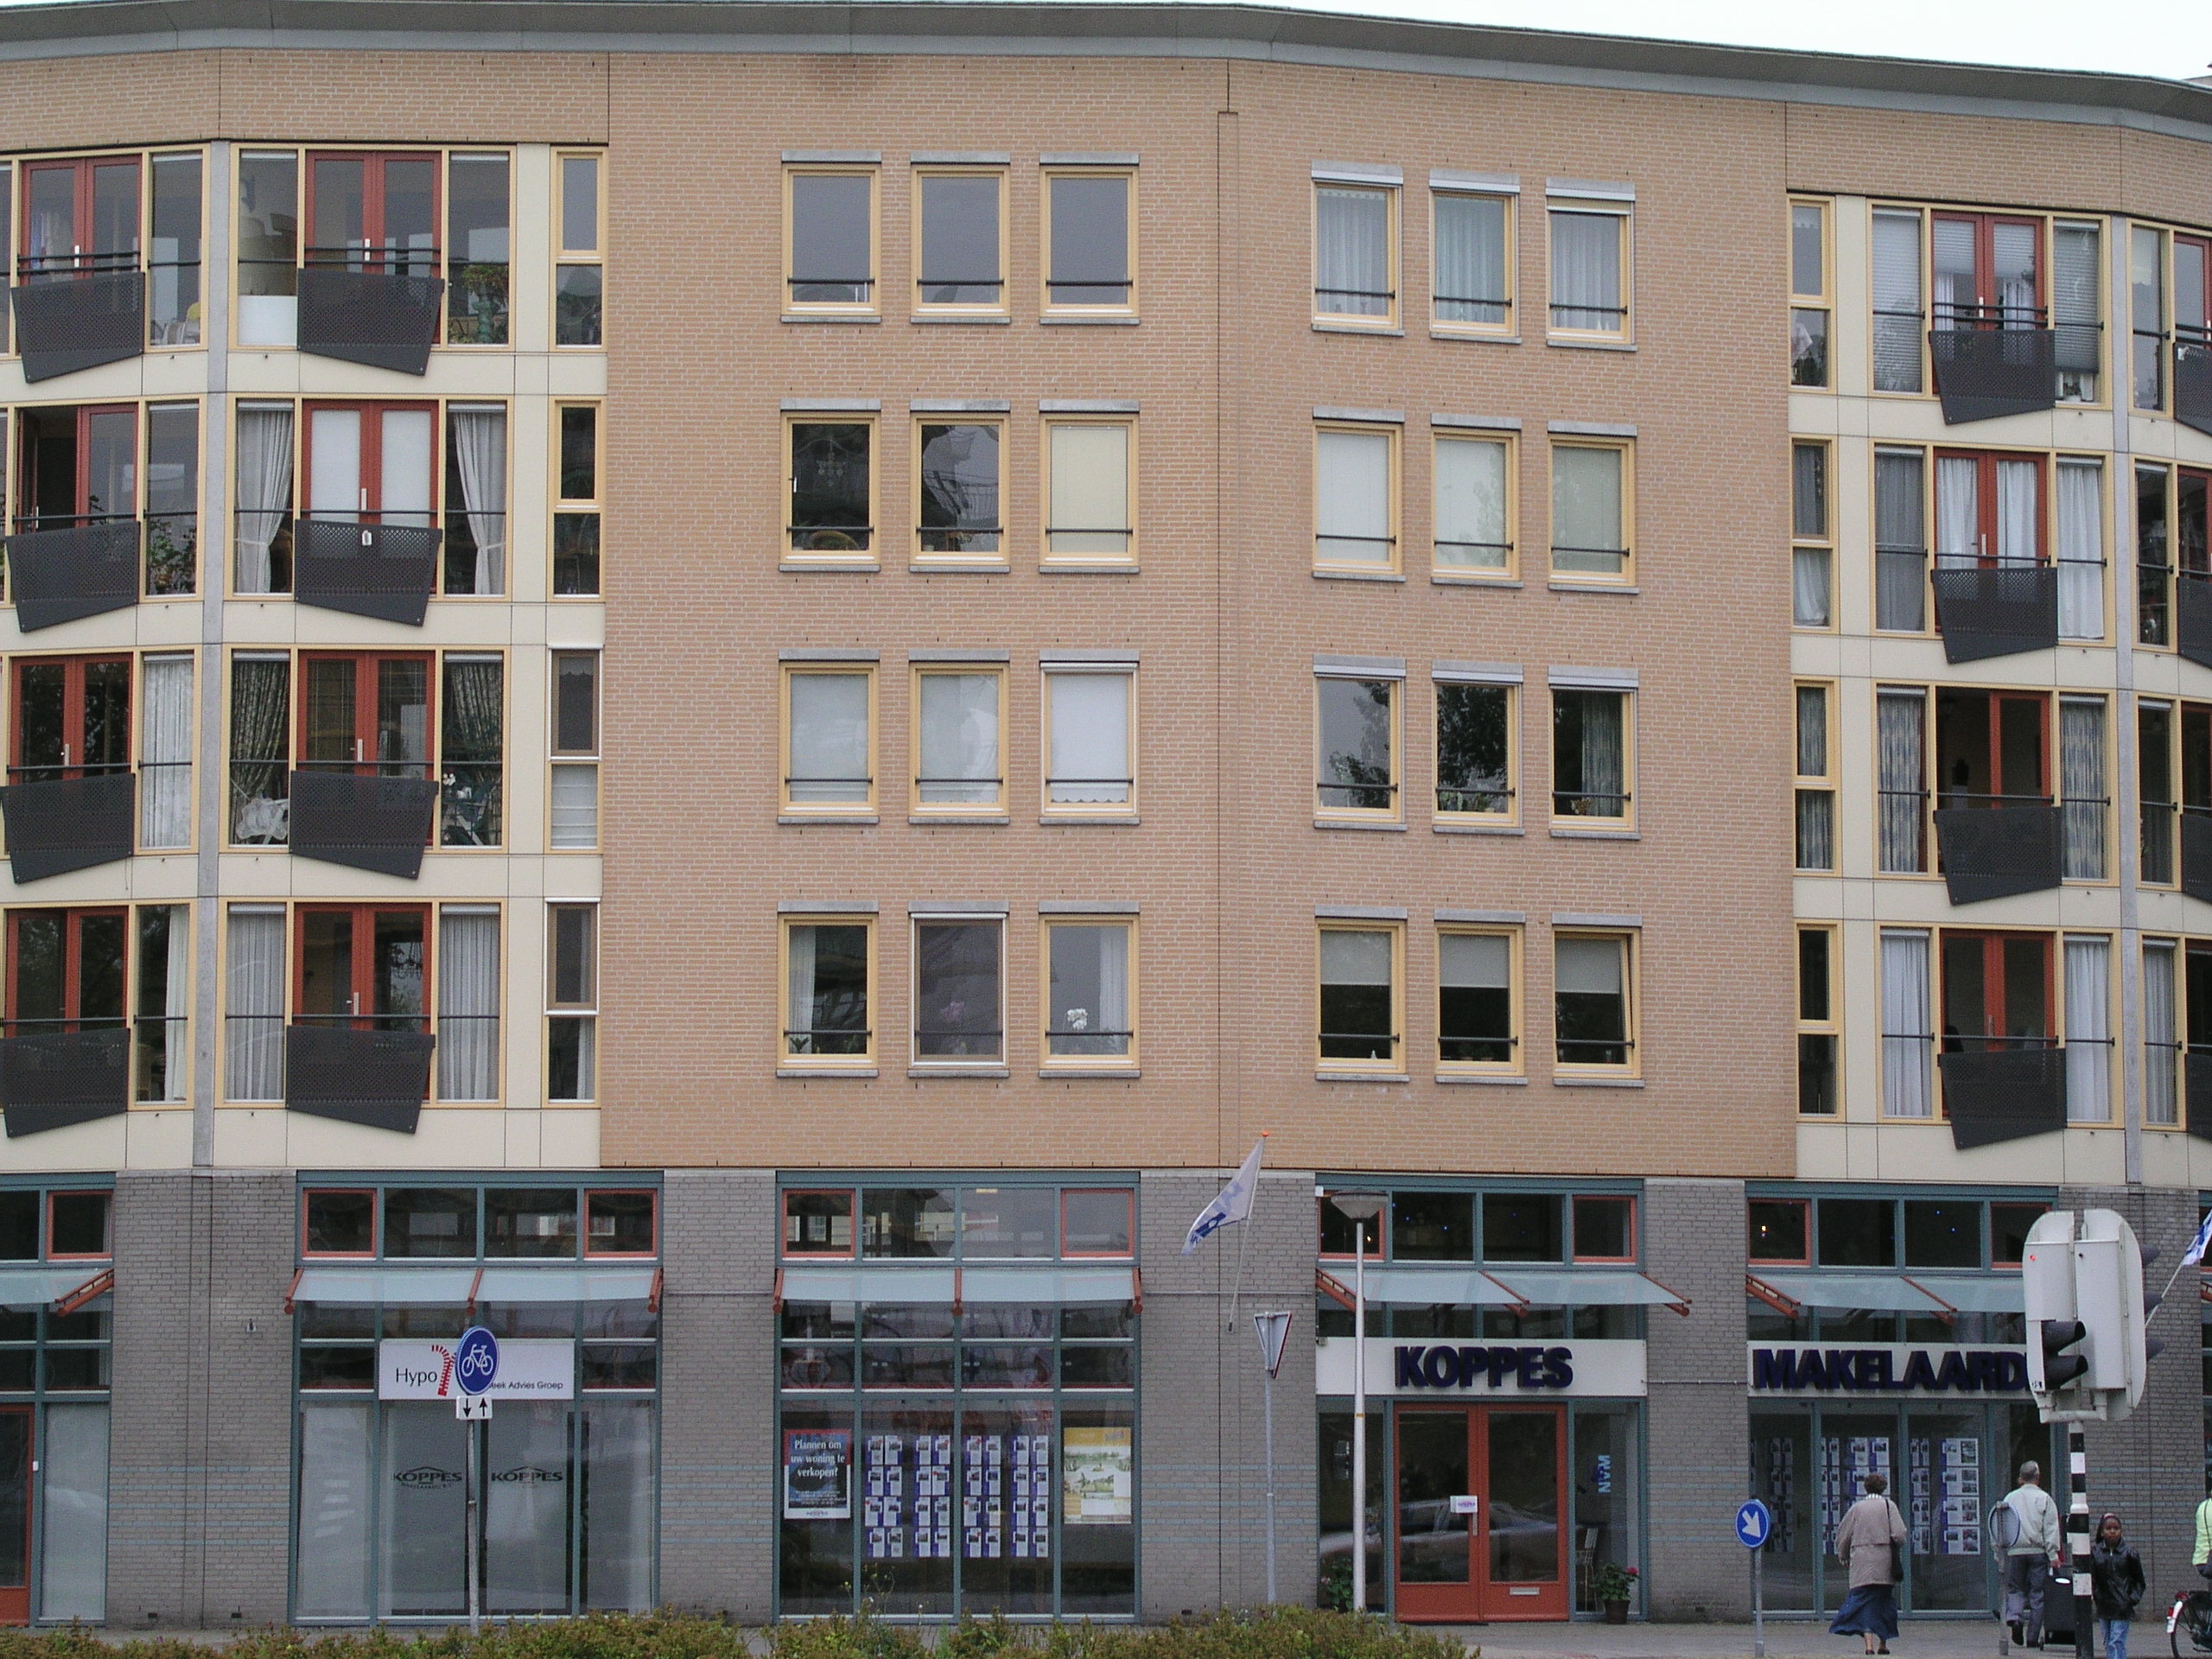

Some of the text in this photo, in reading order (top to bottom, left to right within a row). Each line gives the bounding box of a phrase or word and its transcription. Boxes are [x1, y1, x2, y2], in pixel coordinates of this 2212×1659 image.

[1394, 1345, 1574, 1389] KOPPES
[1751, 1348, 2028, 1392] MAKELAARD
[396, 1367, 438, 1387] Hypo
[508, 1381, 535, 1389] Advies
[537, 1381, 563, 1389] Groep
[795, 1439, 826, 1450] Plannen
[805, 1452, 836, 1465] woning
[837, 1454, 845, 1463] te
[392, 1471, 462, 1482] KOPPES
[491, 1471, 564, 1482] KOPPES
[797, 1466, 838, 1479] verkopen?
